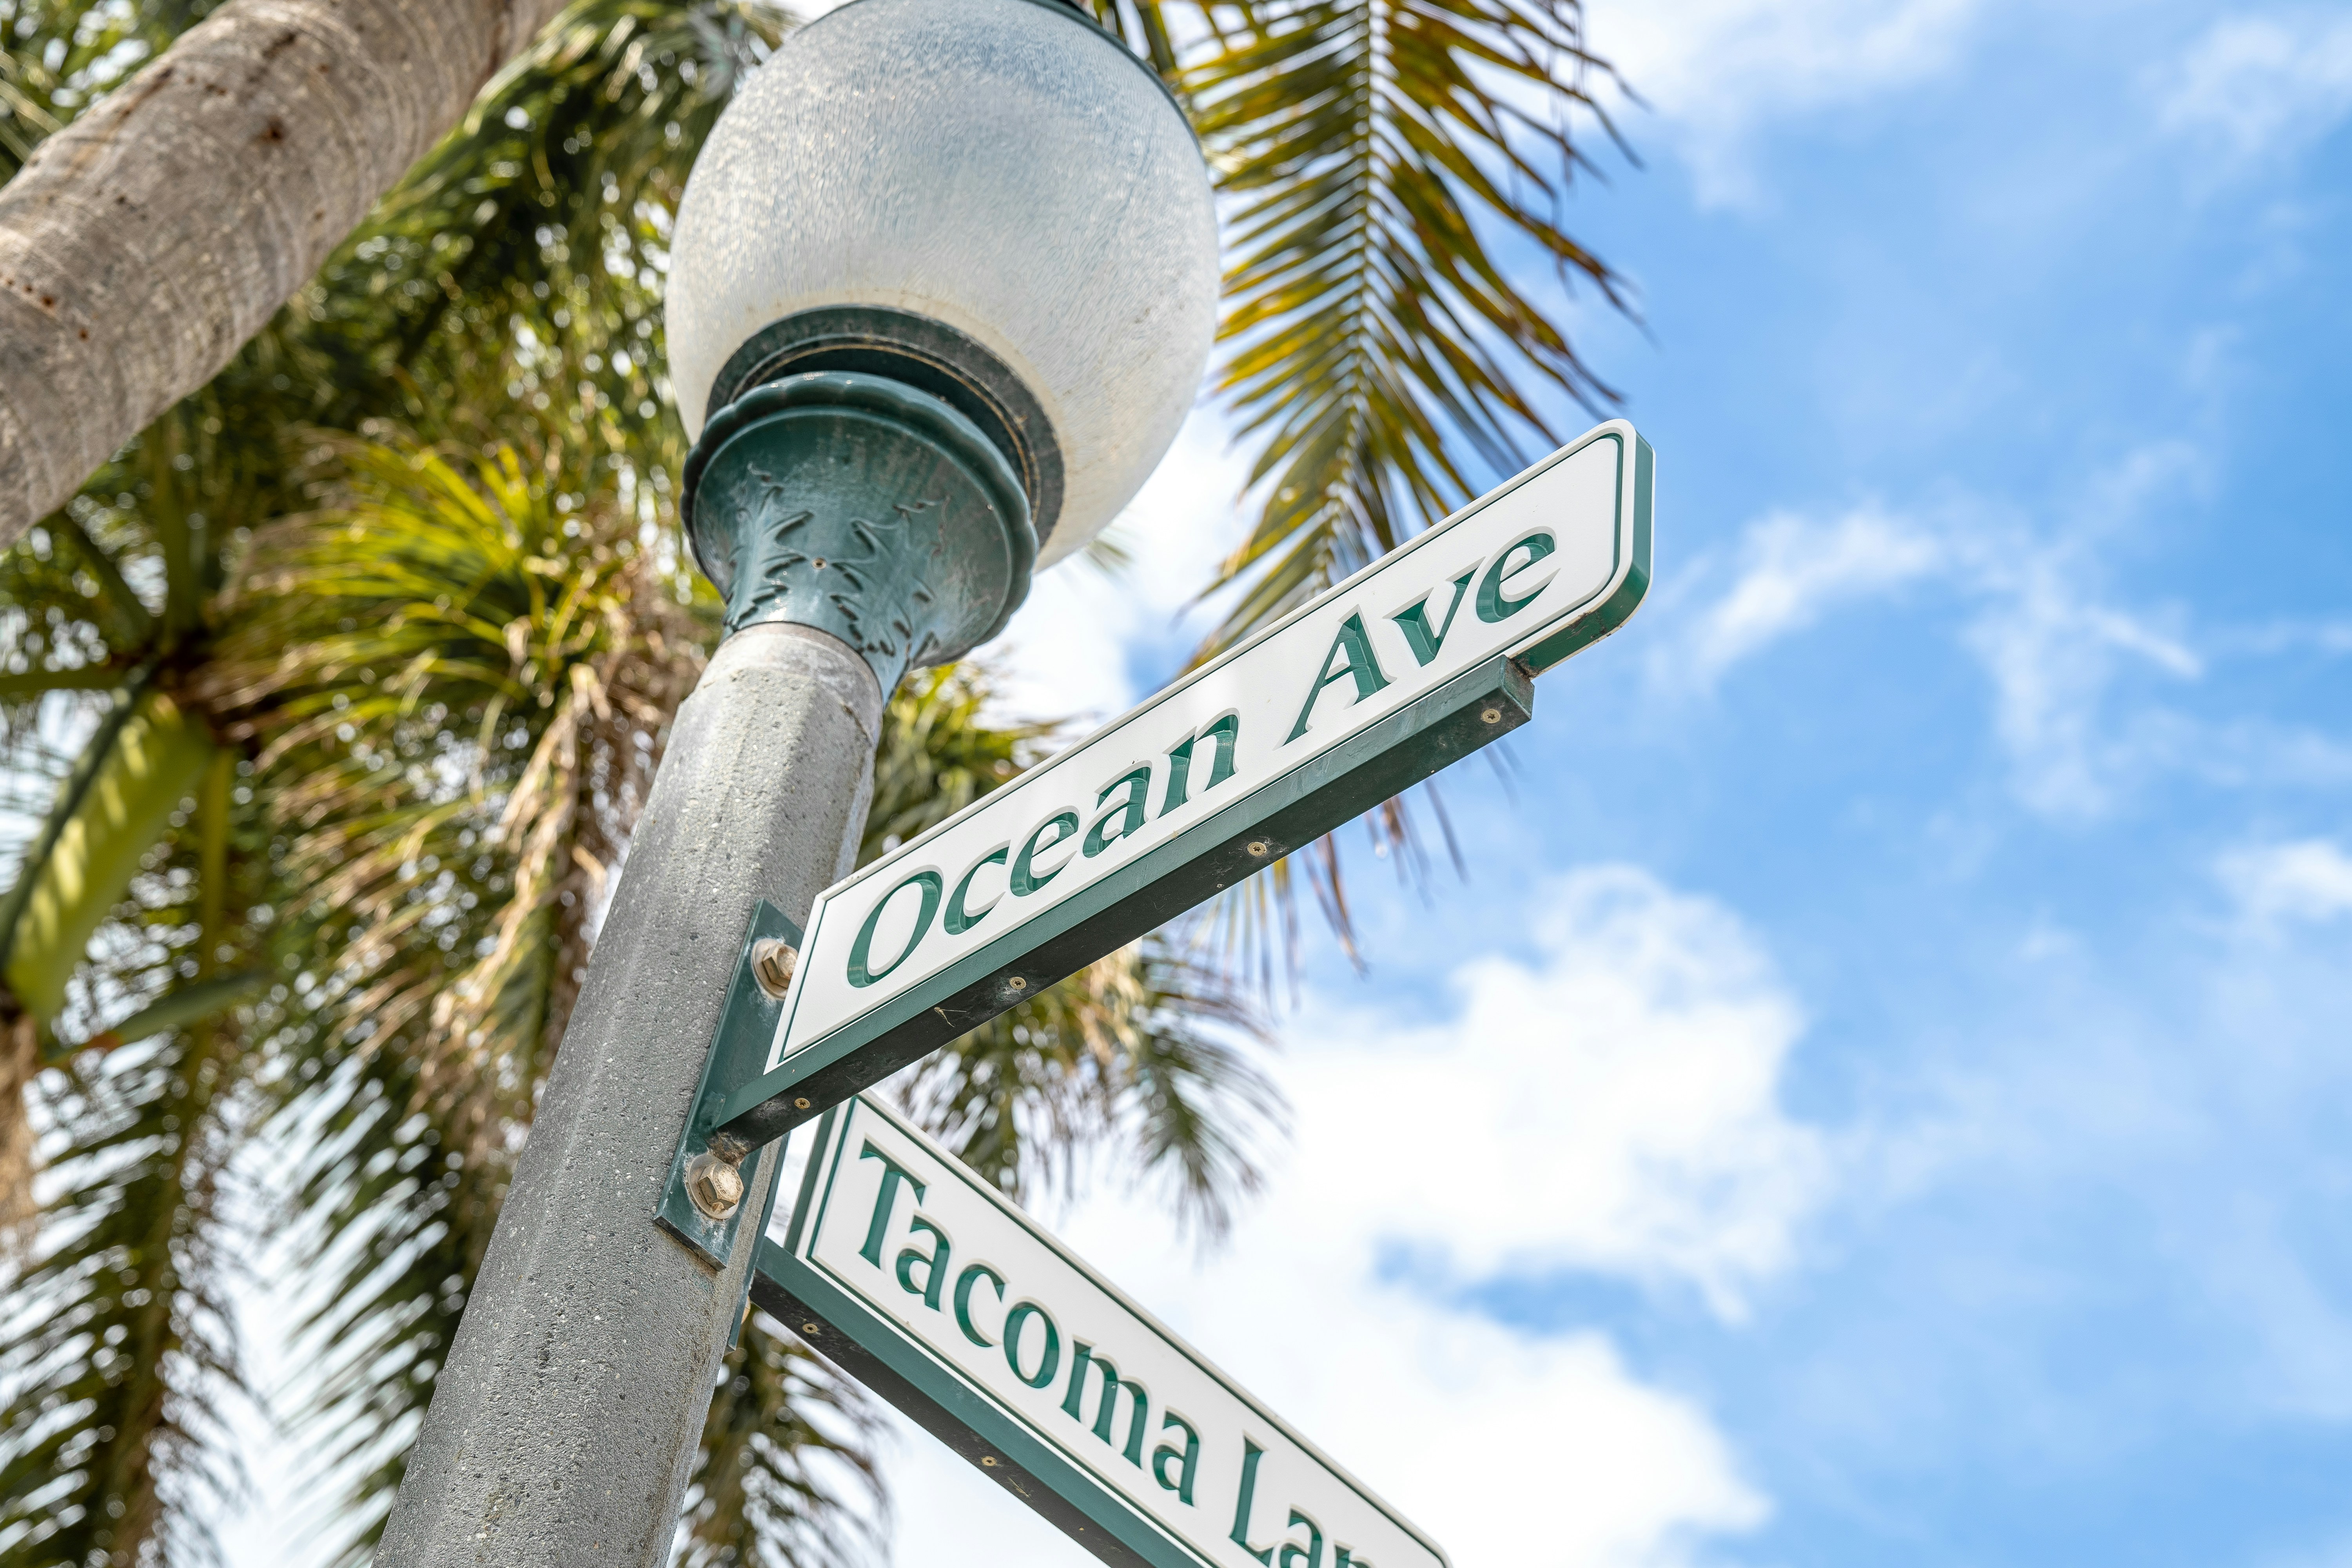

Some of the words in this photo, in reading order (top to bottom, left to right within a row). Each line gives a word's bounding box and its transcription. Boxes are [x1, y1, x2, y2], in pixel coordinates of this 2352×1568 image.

[846, 710, 1241, 989] Ocean
[1280, 529, 1558, 748] Ave
[857, 1138, 1201, 1508] Tacoma
[1229, 1434, 1373, 1568] La
